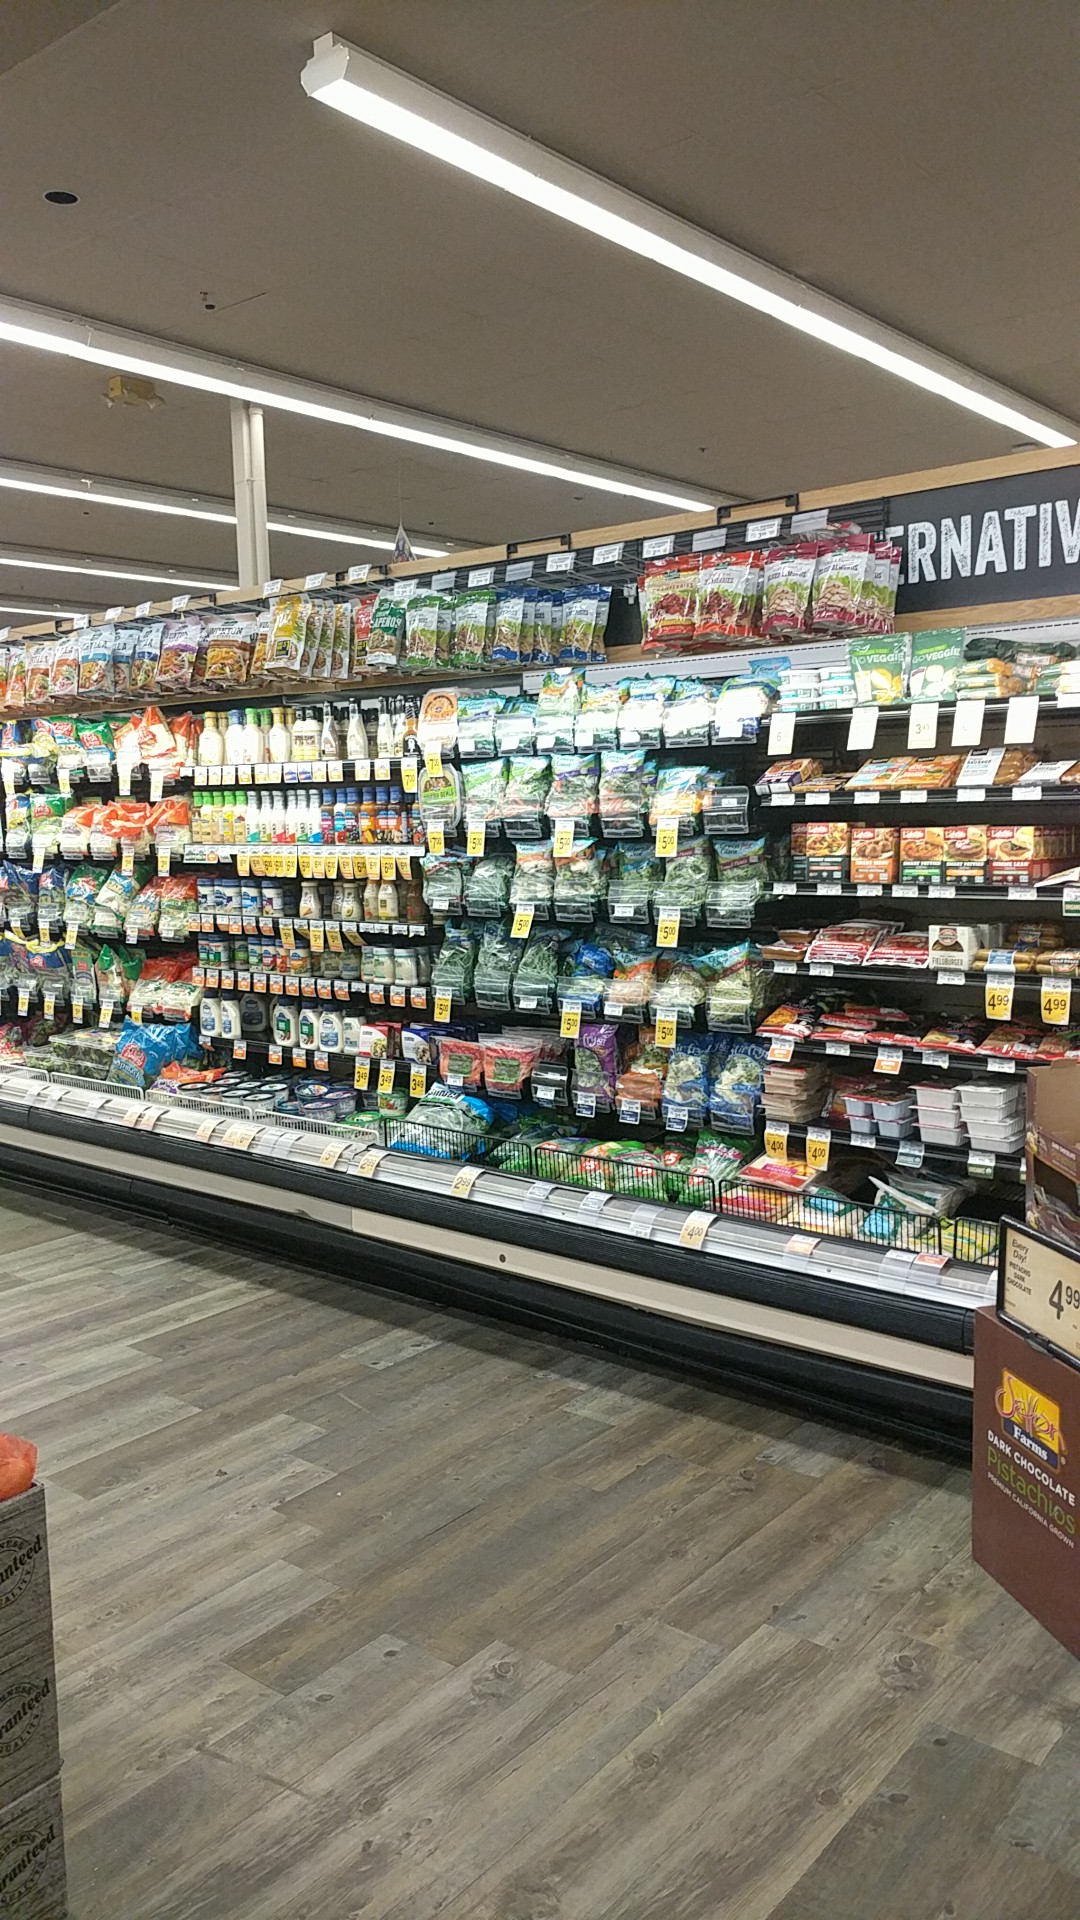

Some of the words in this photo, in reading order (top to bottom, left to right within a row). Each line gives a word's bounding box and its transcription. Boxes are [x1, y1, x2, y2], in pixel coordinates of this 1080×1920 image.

[925, 646, 961, 661] VEGGIE
[1012, 1239, 1029, 1255] Every
[987, 1429, 1012, 1458] DARK
[1013, 1452, 1076, 1507] CHOCOLATE
[1013, 1424, 1049, 1462] Farms
[987, 1471, 1012, 1499] PREMIUM
[1012, 1493, 1049, 1528] CALIFORNIA
[1048, 1523, 1075, 1549] GROWN
[0, 1824, 56, 1892] ranteed
